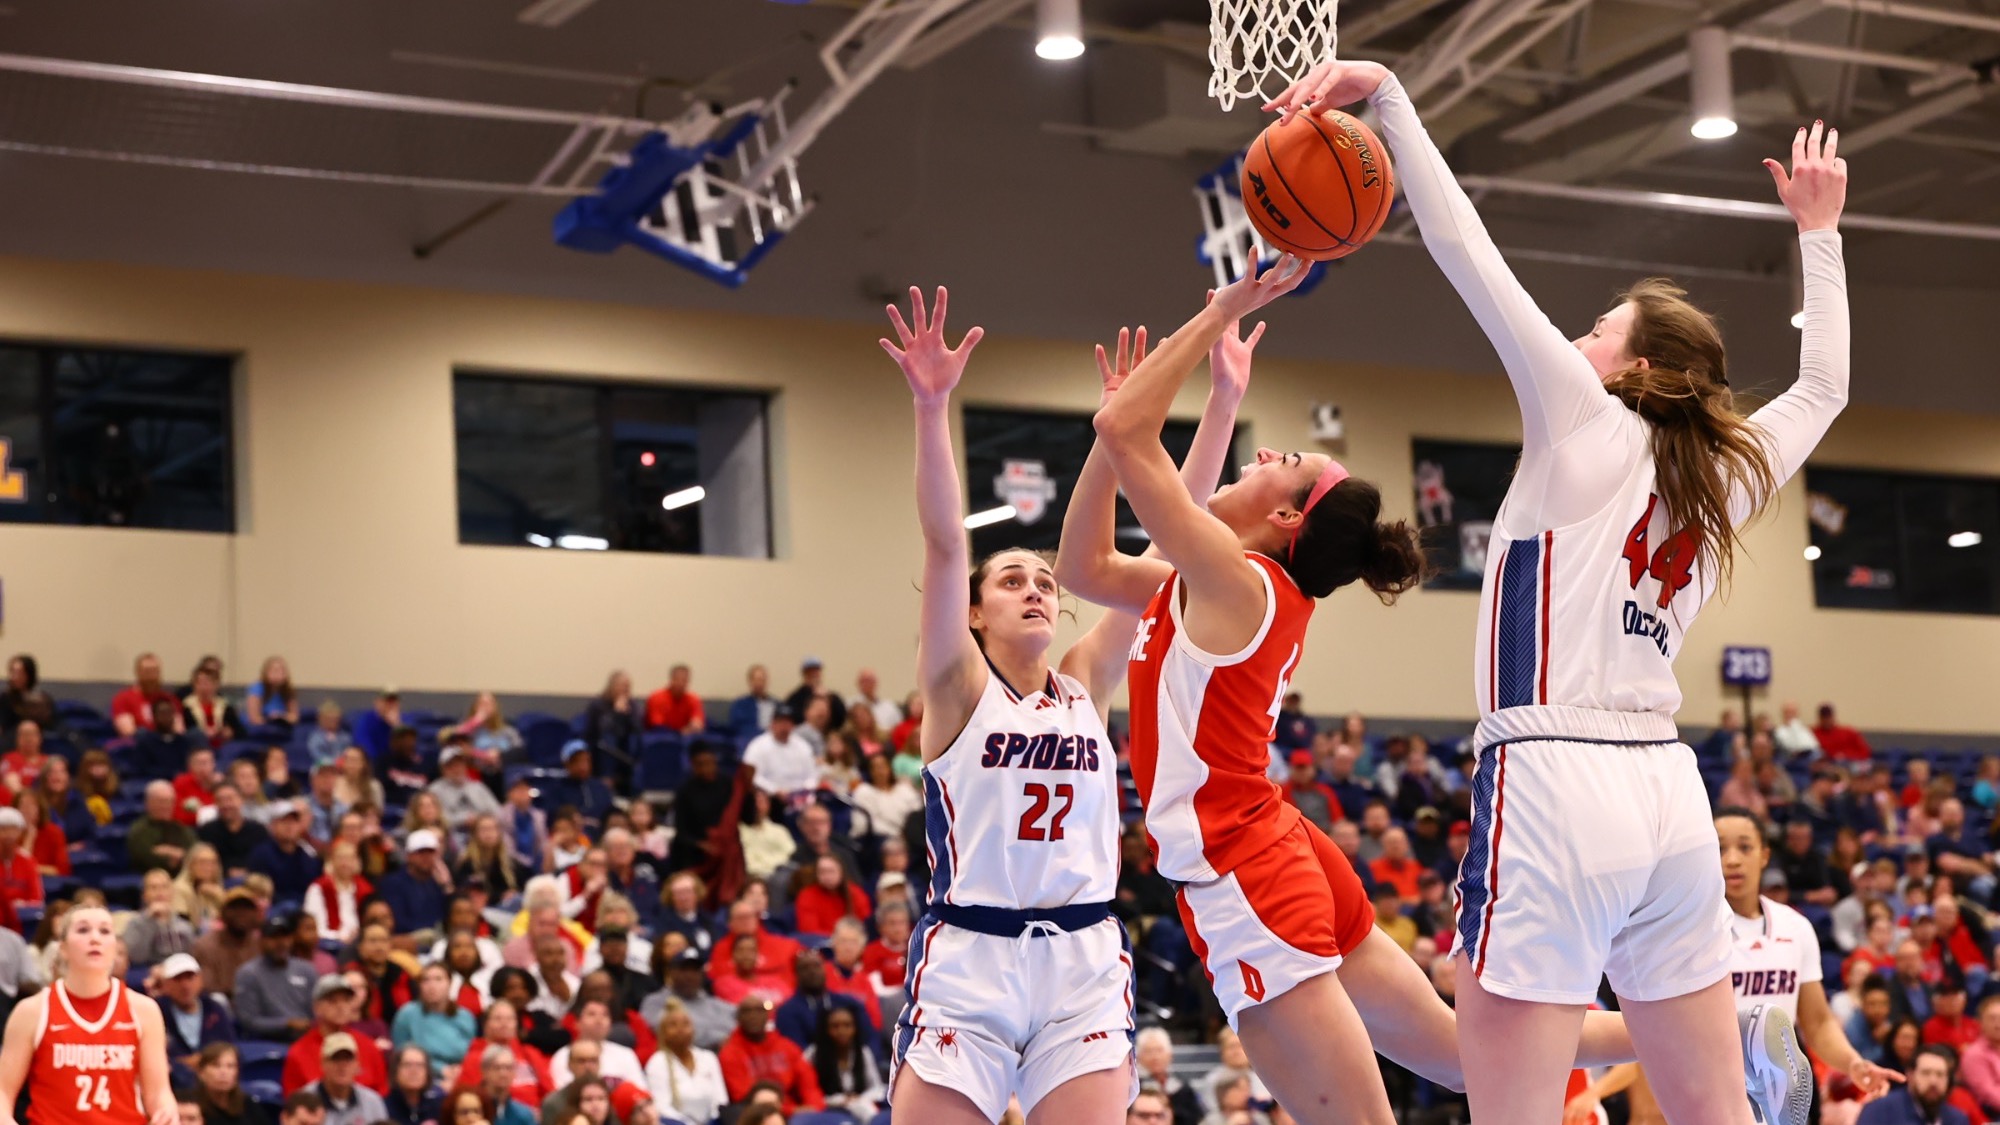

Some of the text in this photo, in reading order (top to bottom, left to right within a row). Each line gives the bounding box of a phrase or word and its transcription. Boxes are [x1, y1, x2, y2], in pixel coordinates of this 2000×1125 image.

[1327, 111, 1380, 190] SPALDIN
[1247, 170, 1291, 230] A10
[981, 732, 1099, 772] SPIDERS
[1017, 782, 1074, 842] 22
[1732, 970, 1797, 997] PIDERS
[53, 1043, 136, 1072] DUQUESNE
[75, 1075, 112, 1111] 24
